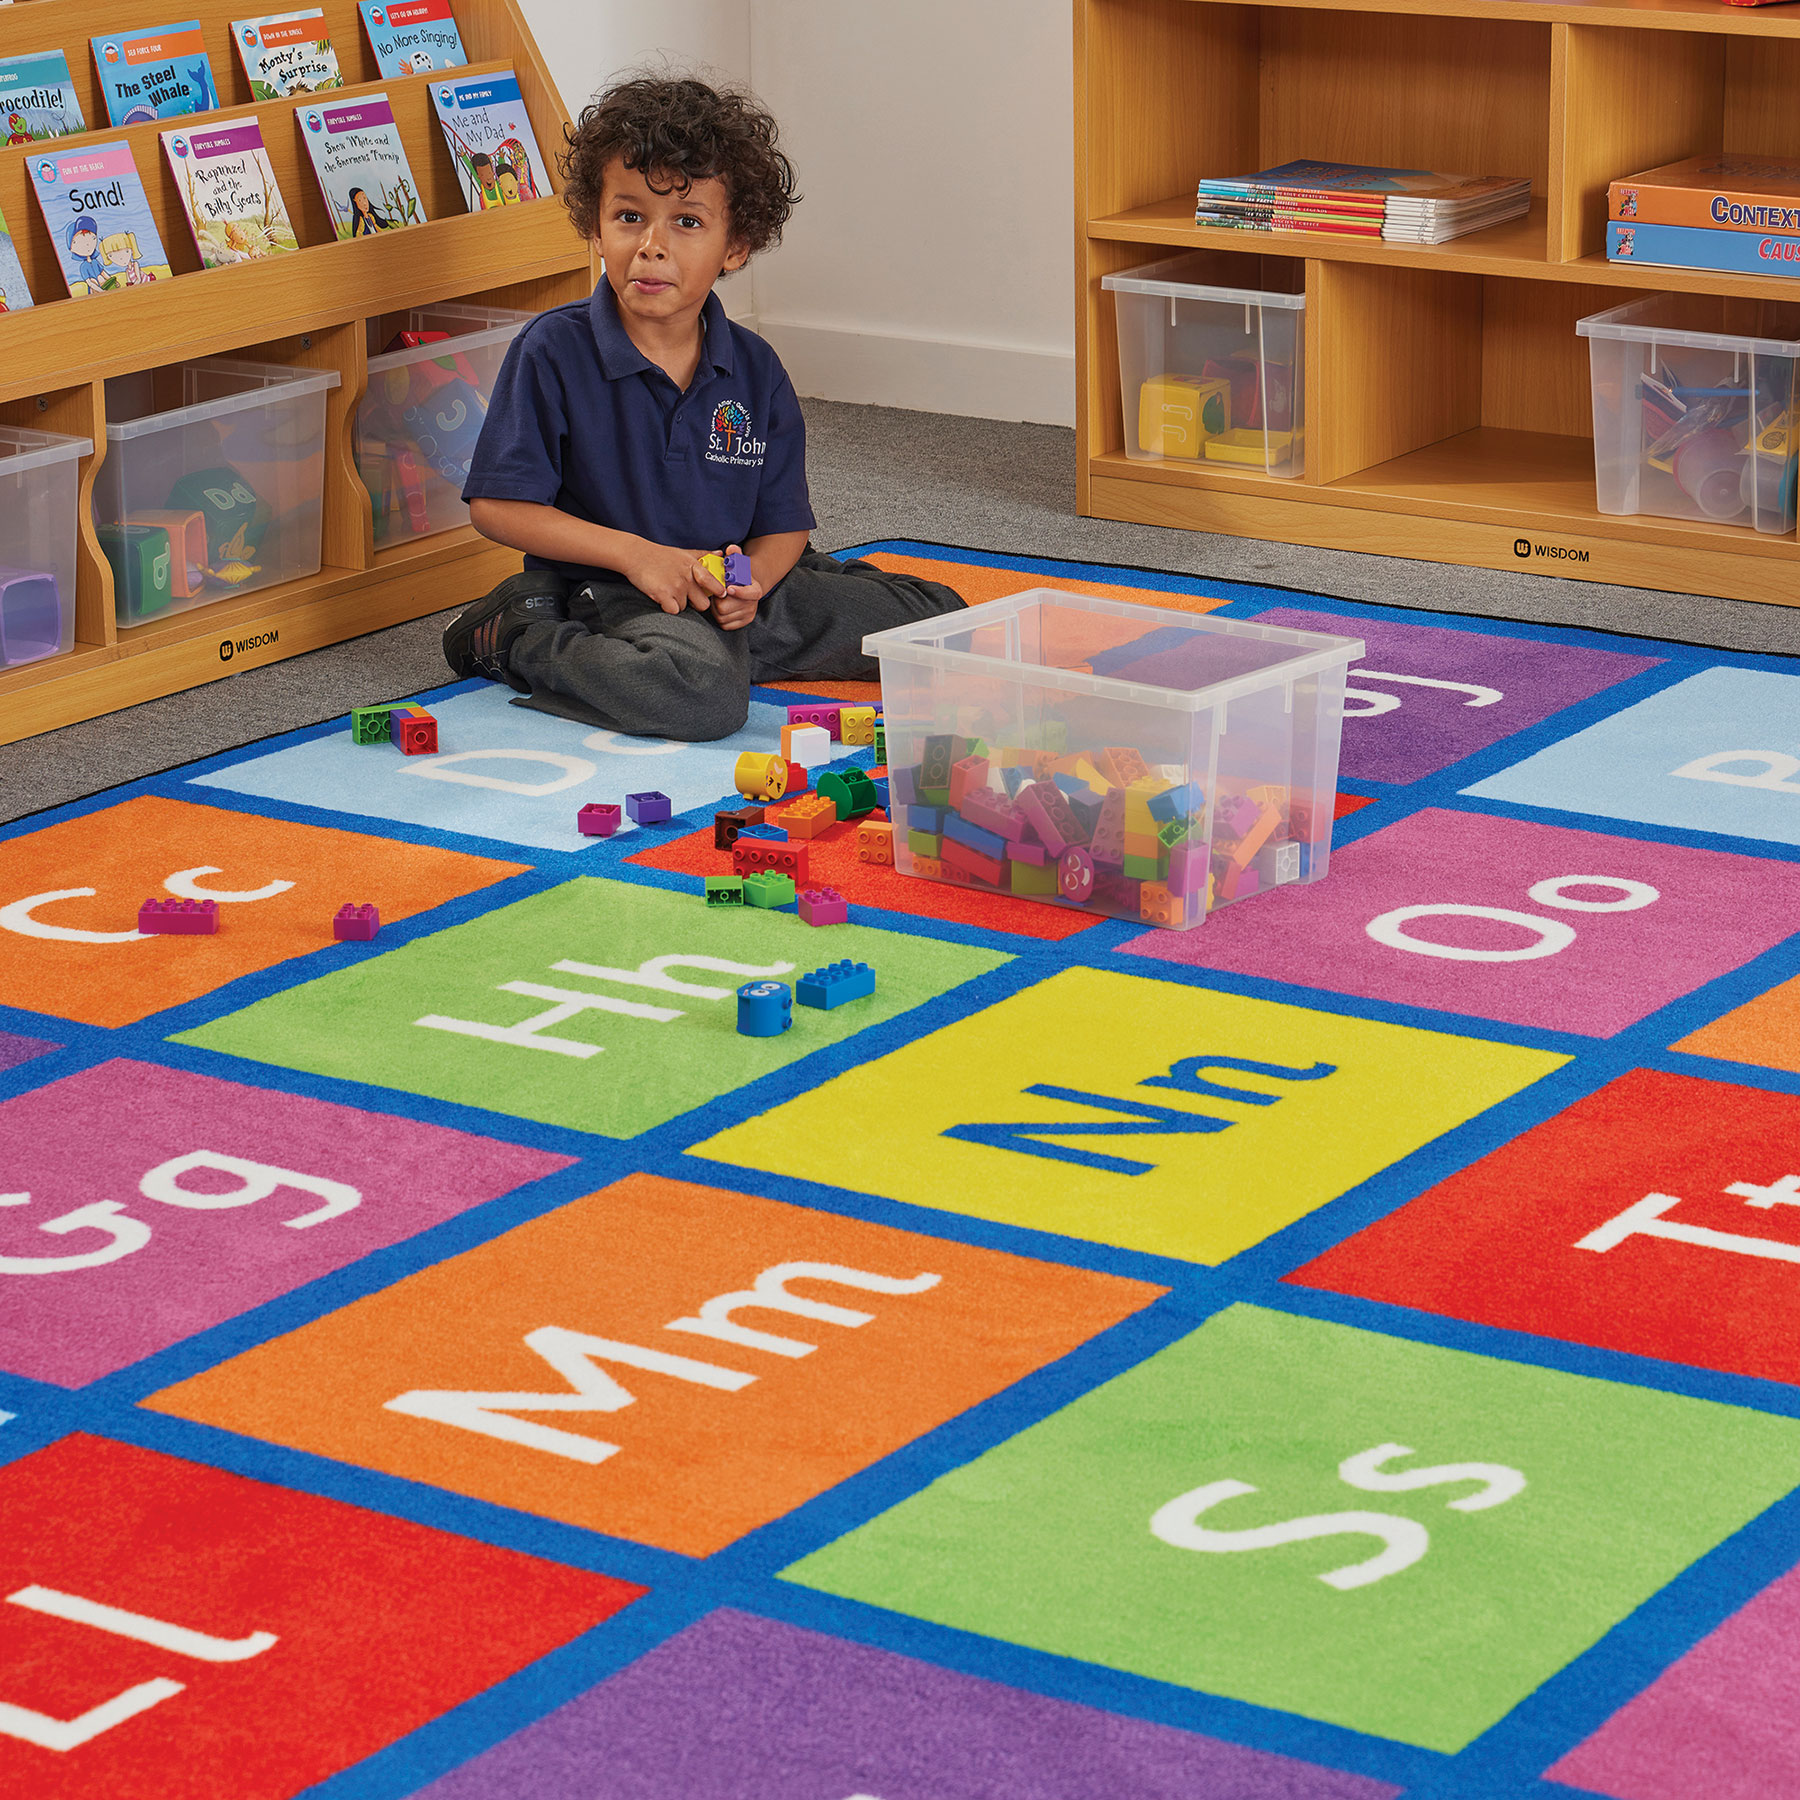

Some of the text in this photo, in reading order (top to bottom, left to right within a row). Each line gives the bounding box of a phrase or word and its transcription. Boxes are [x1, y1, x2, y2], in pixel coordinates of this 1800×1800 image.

[377, 29, 457, 58] No More Singing!
[259, 47, 303, 74] Monty's
[279, 60, 327, 84] Surprise
[115, 65, 176, 98] The Steel
[148, 82, 190, 108] Whale
[452, 107, 490, 131] Me and
[324, 134, 390, 155] Snow White and
[465, 124, 506, 146] My Dad
[195, 158, 247, 185] Rapunzel
[324, 149, 400, 173] the Enormous Turnip
[69, 182, 125, 213] Sand!
[213, 178, 243, 196] and the
[205, 191, 261, 218] Billy Goats
[708, 433, 723, 451] St.
[705, 451, 730, 464] Catholic
[730, 456, 757, 468] Primary
[1534, 544, 1589, 562] WISDOM
[236, 630, 279, 653] WISDOM
[1365, 874, 1660, 962] Oo
[411, 953, 797, 1060] Hh
[938, 1055, 1339, 1177] Nn
[382, 1261, 942, 1465] Mm
[1150, 1442, 1527, 1591] Ss
